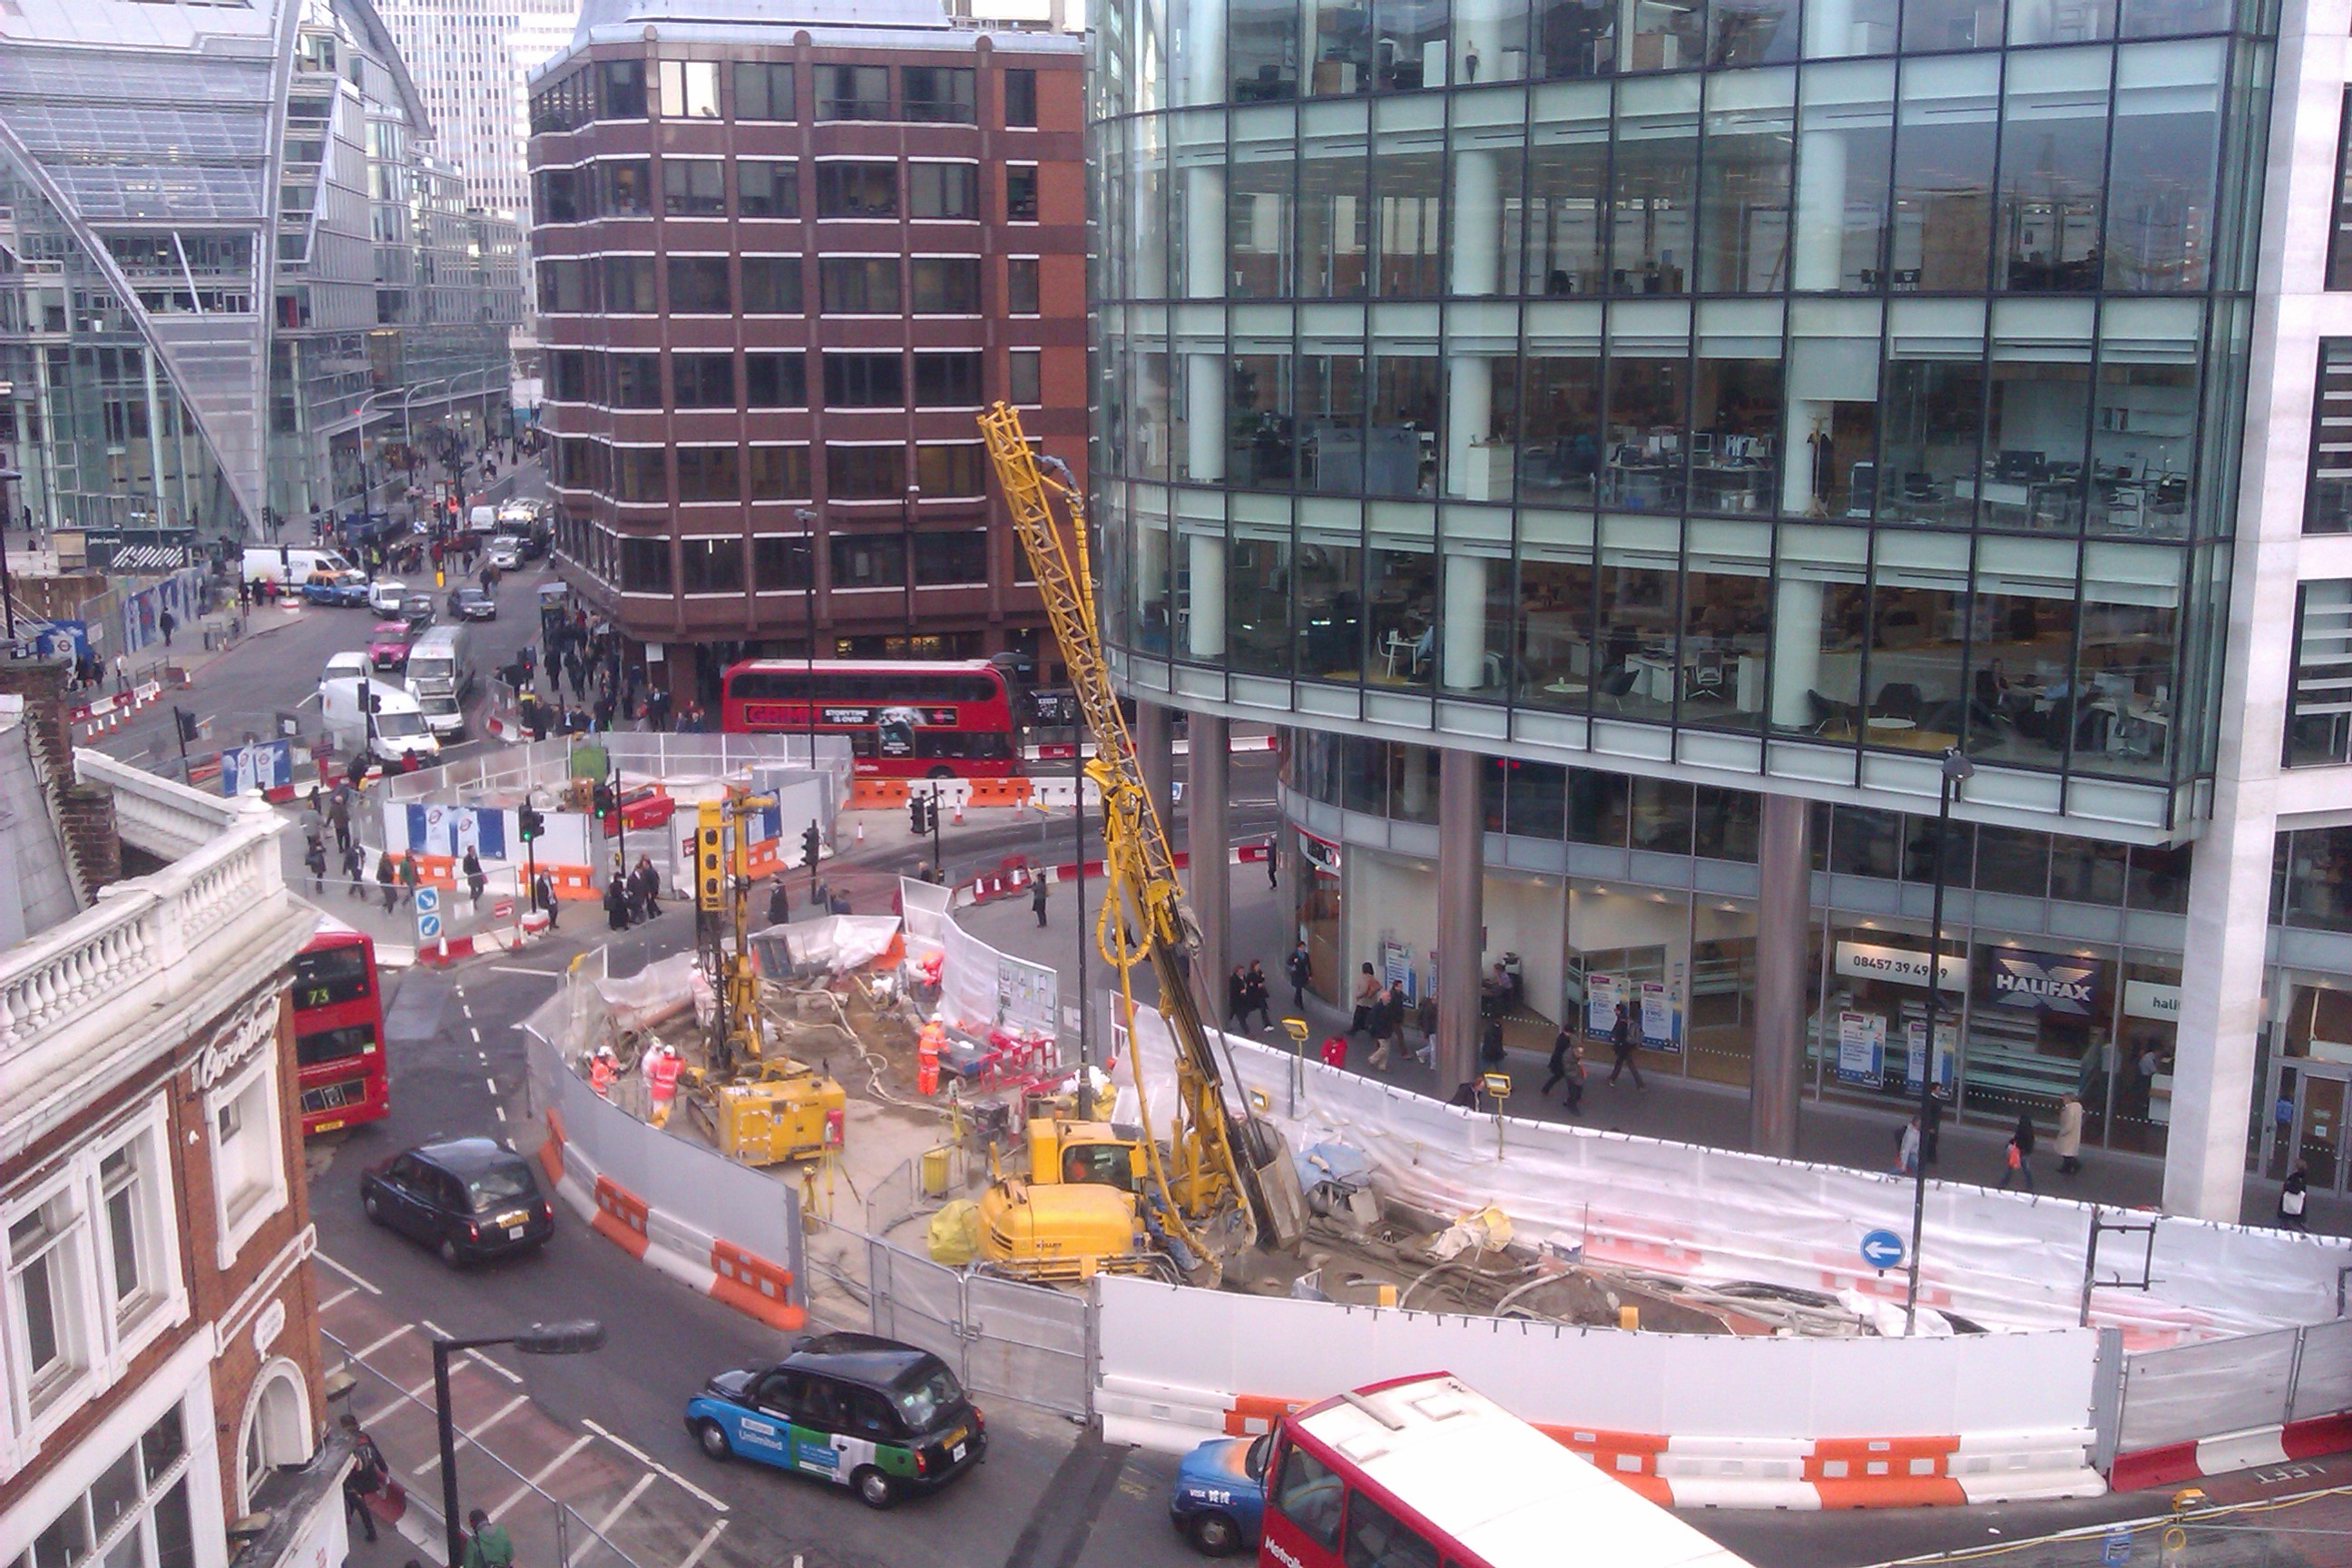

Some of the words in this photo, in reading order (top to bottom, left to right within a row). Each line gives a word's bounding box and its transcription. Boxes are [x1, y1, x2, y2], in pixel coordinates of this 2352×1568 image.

[1853, 956, 1891, 970] 08457
[1895, 962, 1910, 973] 39
[1913, 965, 1928, 975] 49
[309, 987, 329, 1004] 73
[1996, 974, 2091, 1002] HALIFAX
[2152, 996, 2180, 1010] hali
[2254, 1464, 2326, 1485] LEFT
